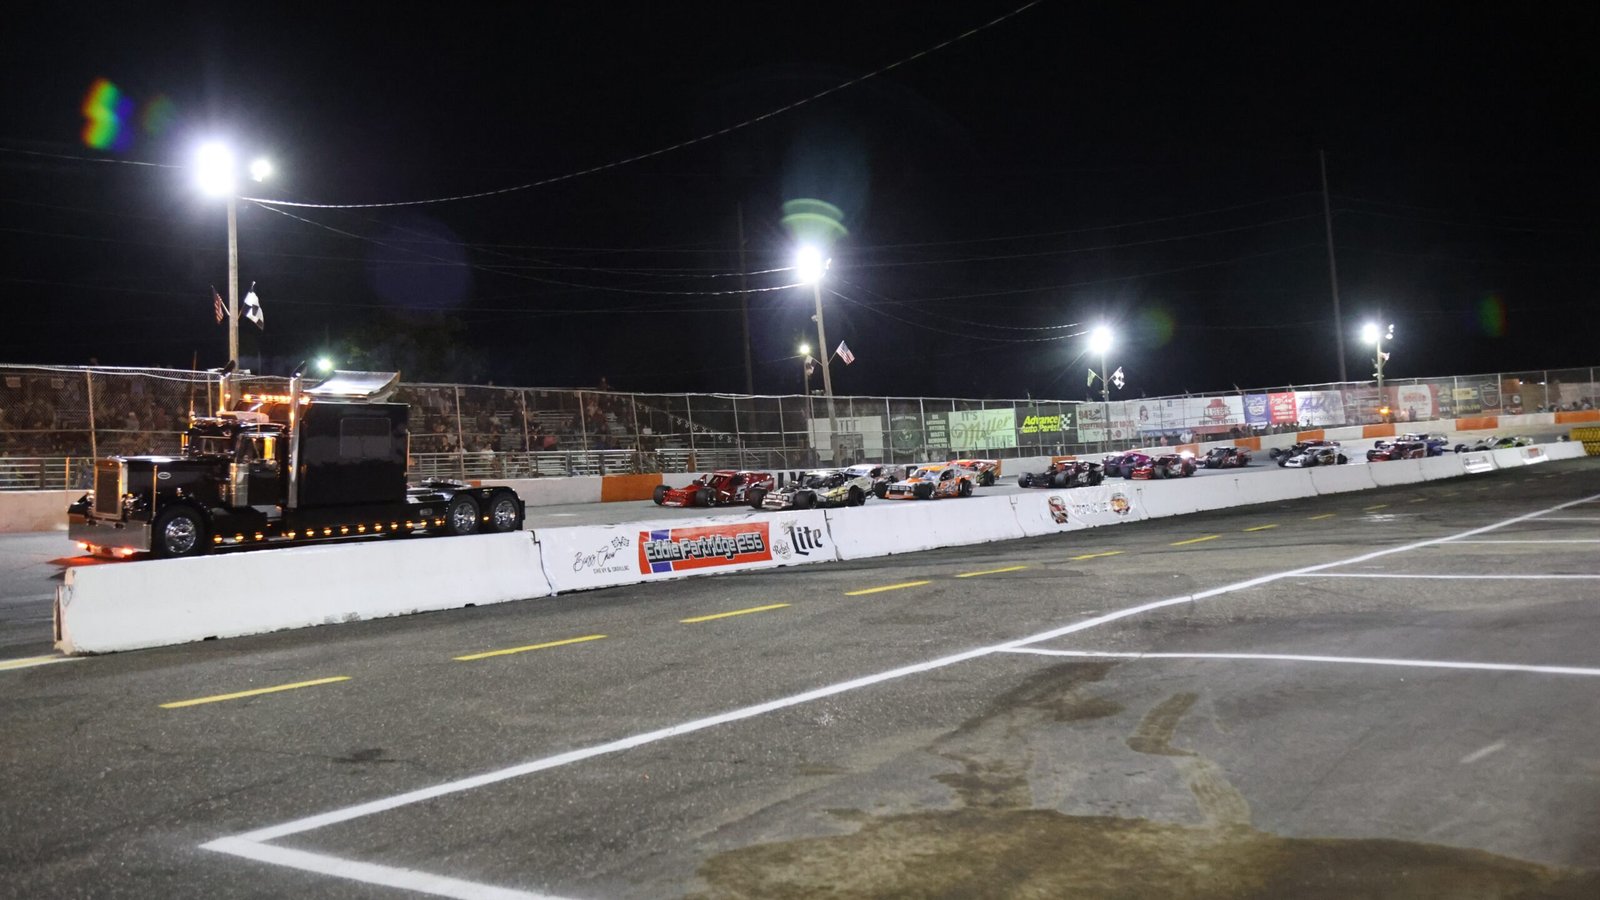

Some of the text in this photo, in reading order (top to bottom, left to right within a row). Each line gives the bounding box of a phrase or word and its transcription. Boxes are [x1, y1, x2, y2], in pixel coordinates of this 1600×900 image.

[961, 411, 978, 421] IT'S
[1023, 415, 1060, 426] Advance
[951, 416, 1012, 448] Miller
[985, 435, 1013, 447] TIME
[645, 532, 765, 562] Eddie Partridge 256
[785, 526, 823, 556] Lite
